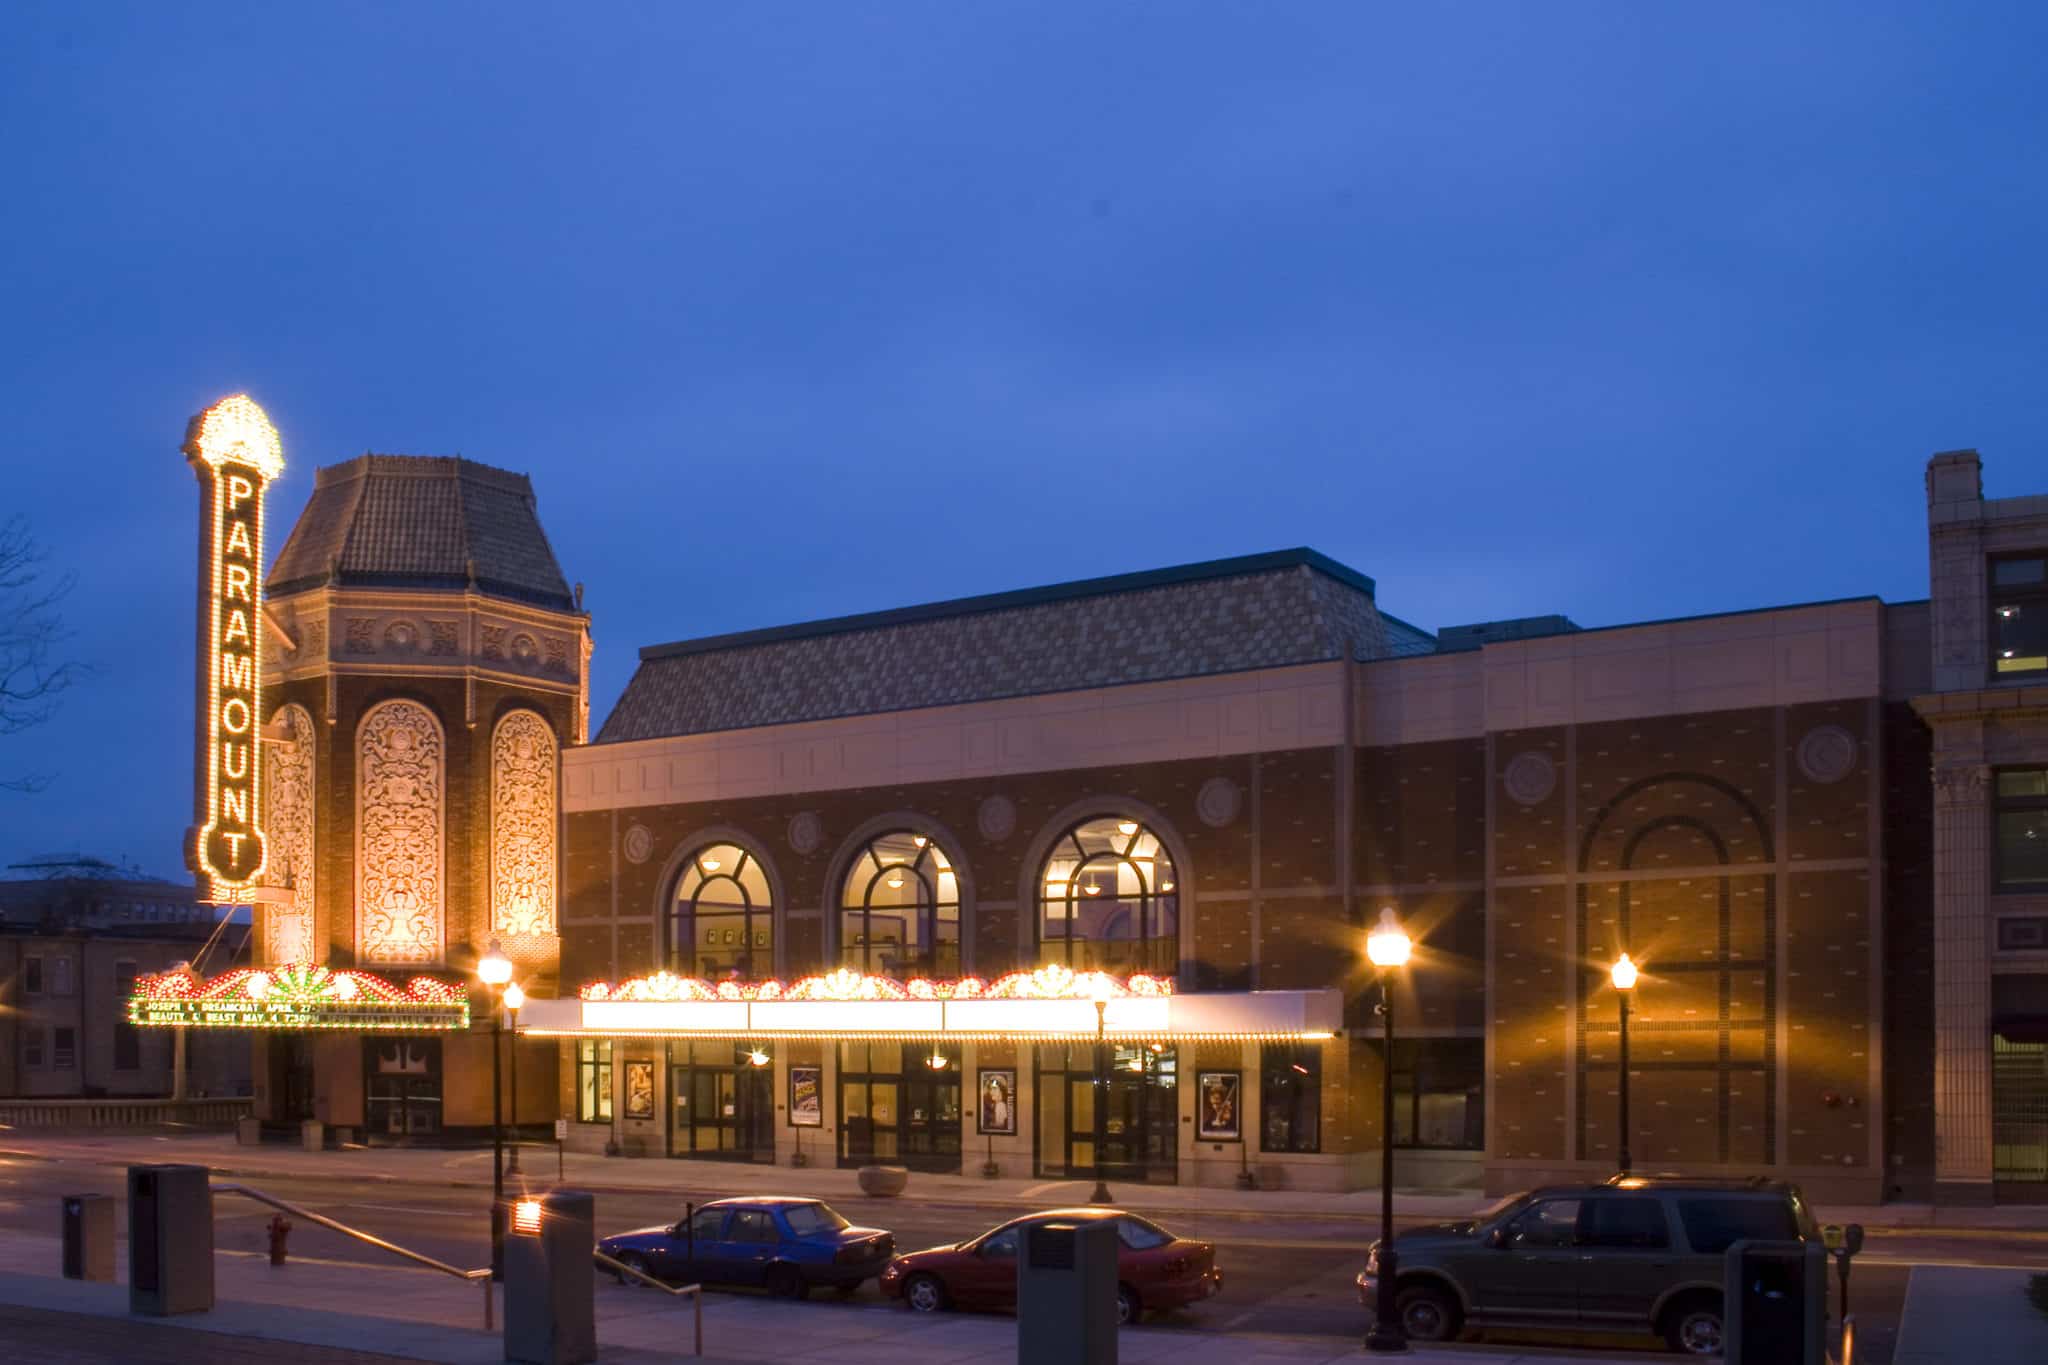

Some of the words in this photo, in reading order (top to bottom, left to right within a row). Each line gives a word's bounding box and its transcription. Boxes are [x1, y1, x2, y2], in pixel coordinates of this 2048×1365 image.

[222, 476, 253, 868] PARAMOUNT
[146, 1002, 182, 1012] JOSEPH
[188, 1003, 195, 1012] &
[201, 1003, 259, 1012] DREAMCOAT
[266, 1004, 294, 1013] APRIL
[149, 1012, 185, 1021] BEAUTY
[192, 1012, 199, 1021] &
[206, 1013, 237, 1022] BEAST
[242, 1013, 264, 1022] MAY
[271, 1014, 278, 1022] 4
